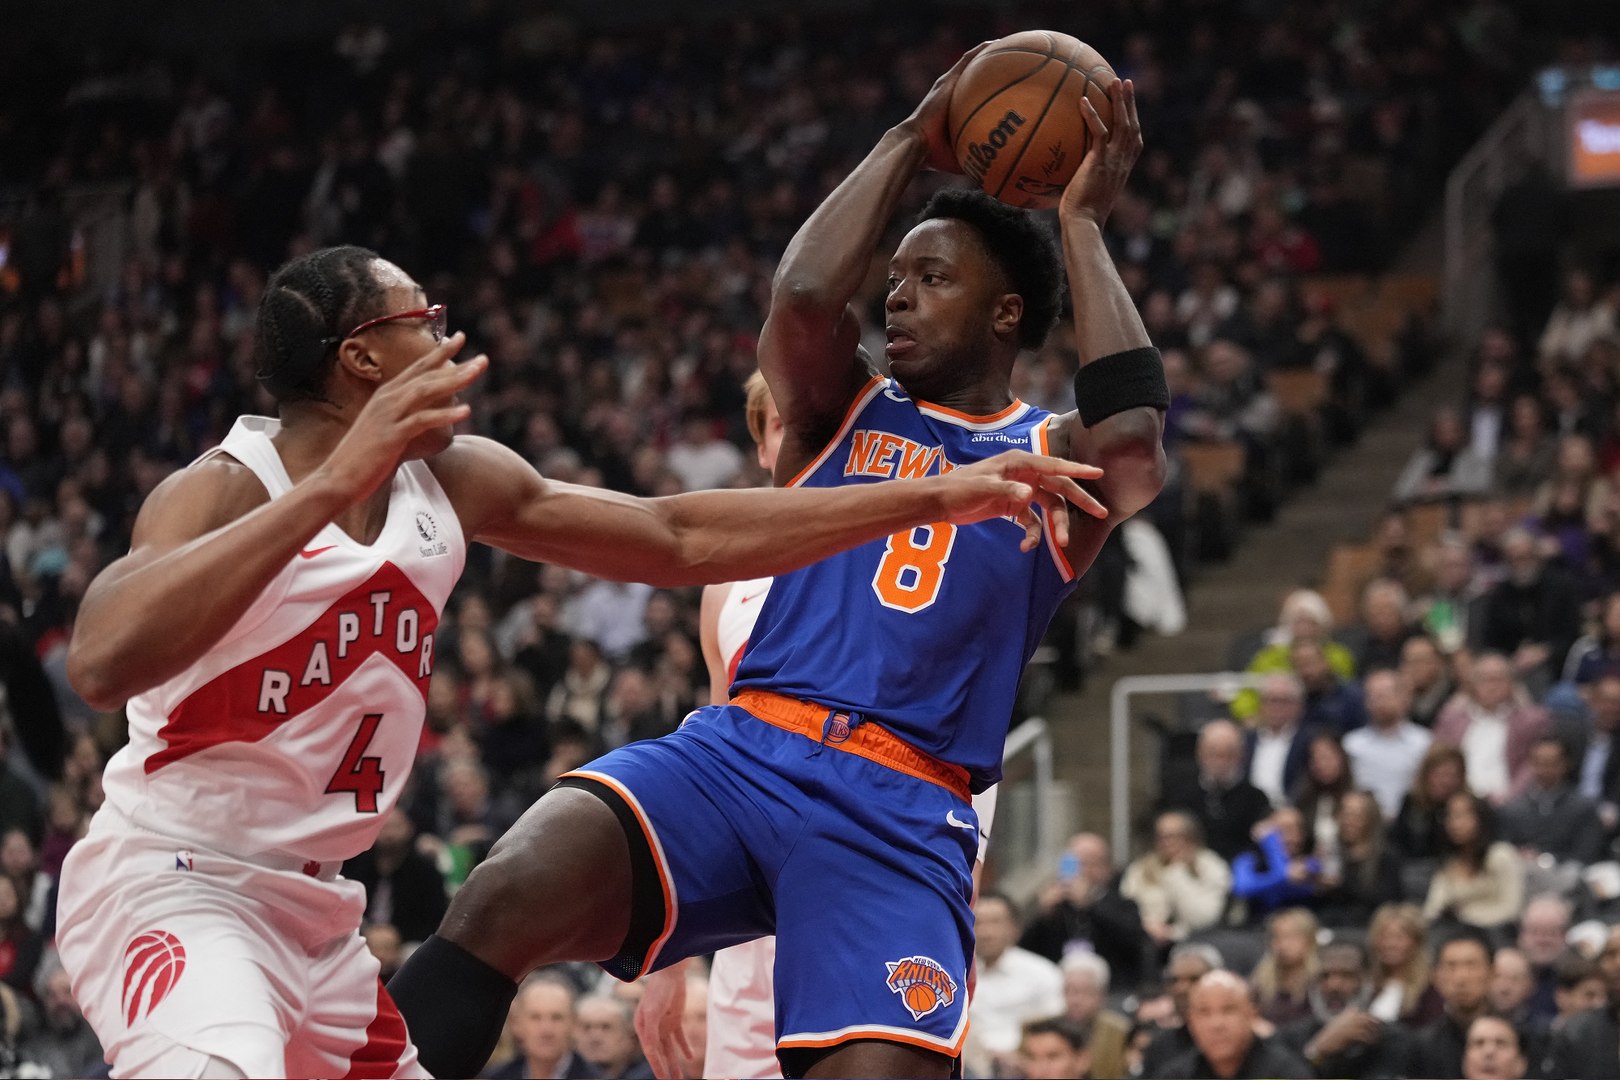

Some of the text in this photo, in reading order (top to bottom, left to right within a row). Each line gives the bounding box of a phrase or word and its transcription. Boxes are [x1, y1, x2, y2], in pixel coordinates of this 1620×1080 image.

[843, 429, 943, 480] NEW
[996, 435, 1028, 444] dhabi
[419, 545, 434, 558] Sun
[871, 521, 958, 614] 8
[323, 713, 385, 814] 4
[889, 960, 952, 1002] KNICKS
